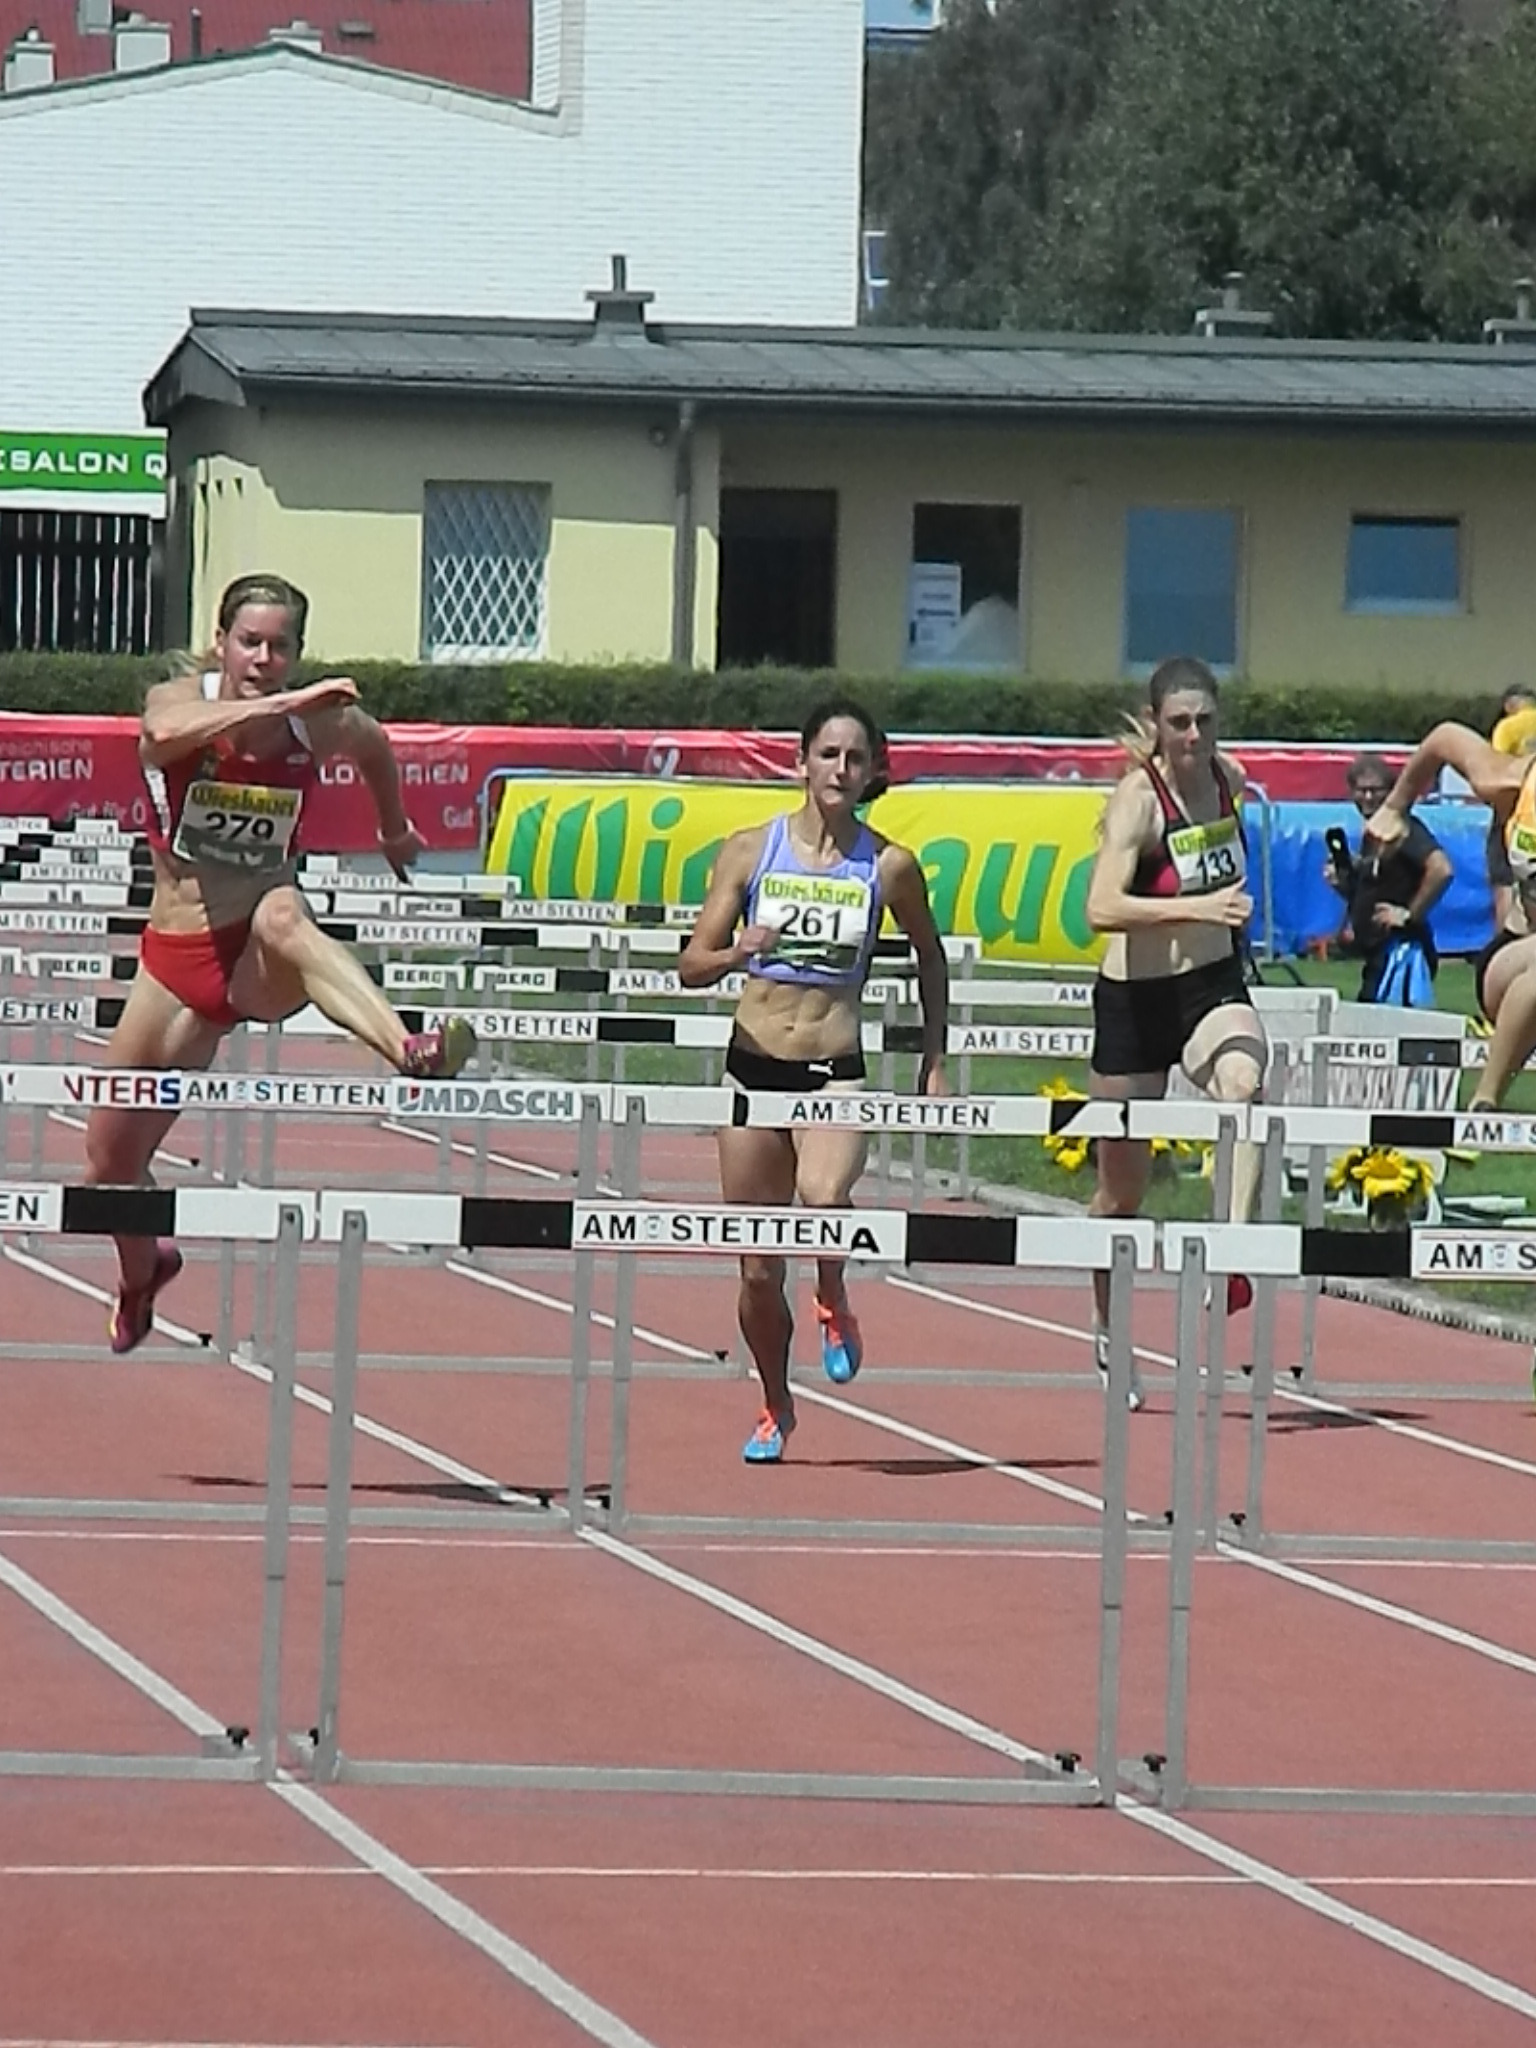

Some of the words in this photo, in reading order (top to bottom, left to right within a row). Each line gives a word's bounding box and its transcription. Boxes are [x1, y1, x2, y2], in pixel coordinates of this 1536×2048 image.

[0, 450, 129, 474] SALON
[319, 764, 469, 785] LORIEN
[206, 812, 275, 841] 279
[1196, 848, 1236, 885] 133
[780, 904, 842, 941] 261
[484, 1015, 592, 1036] STETTEN
[187, 1080, 228, 1100] AM
[255, 1081, 385, 1106] STETTEN
[399, 1085, 574, 1116] UMDASCH
[790, 1101, 833, 1122] AM
[859, 1101, 989, 1126] STETTEN
[1461, 1121, 1503, 1142] AM
[582, 1214, 637, 1240] AM
[671, 1214, 842, 1245] STETTEN
[1429, 1243, 1483, 1269] AM
